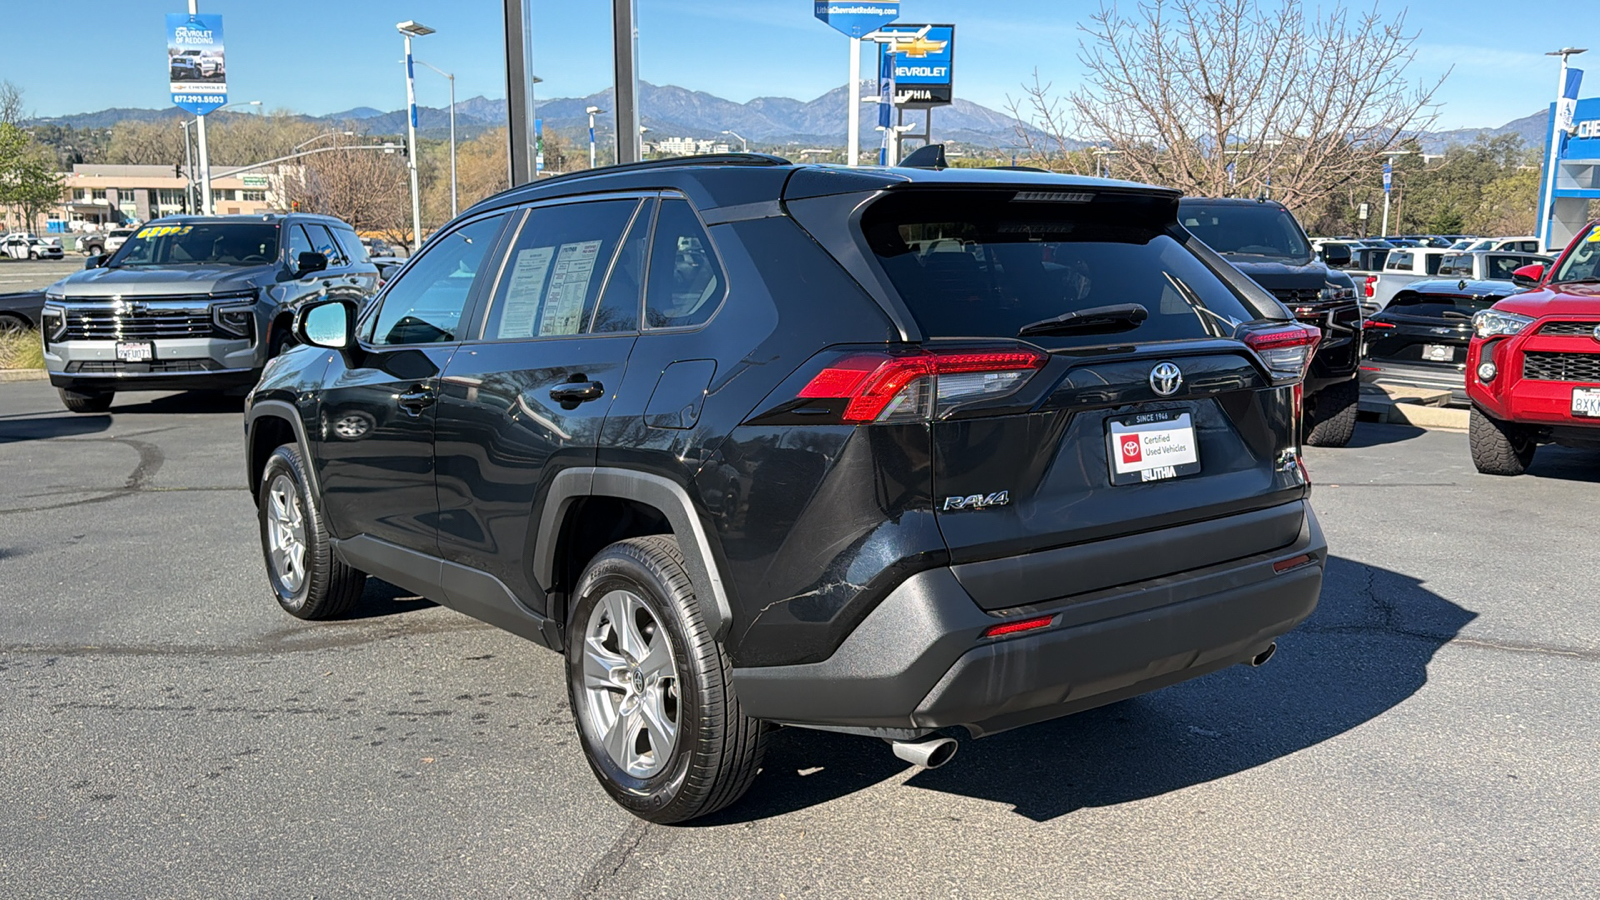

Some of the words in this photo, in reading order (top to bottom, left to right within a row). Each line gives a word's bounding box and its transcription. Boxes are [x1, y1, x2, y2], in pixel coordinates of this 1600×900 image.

[816, 5, 897, 16] LithiaChevroletRedding.com
[175, 30, 213, 38] CHEVROLET
[895, 66, 947, 77] HEVROLET
[173, 95, 224, 104] 877.293.5503
[1136, 413, 1154, 423] SINCE
[1155, 412, 1169, 421] 1946
[1143, 433, 1171, 445] Certified
[1145, 447, 1162, 456] Used
[1161, 443, 1187, 454] Vehicles
[1150, 465, 1177, 480] LITHIA
[942, 489, 1010, 511] RAV4
